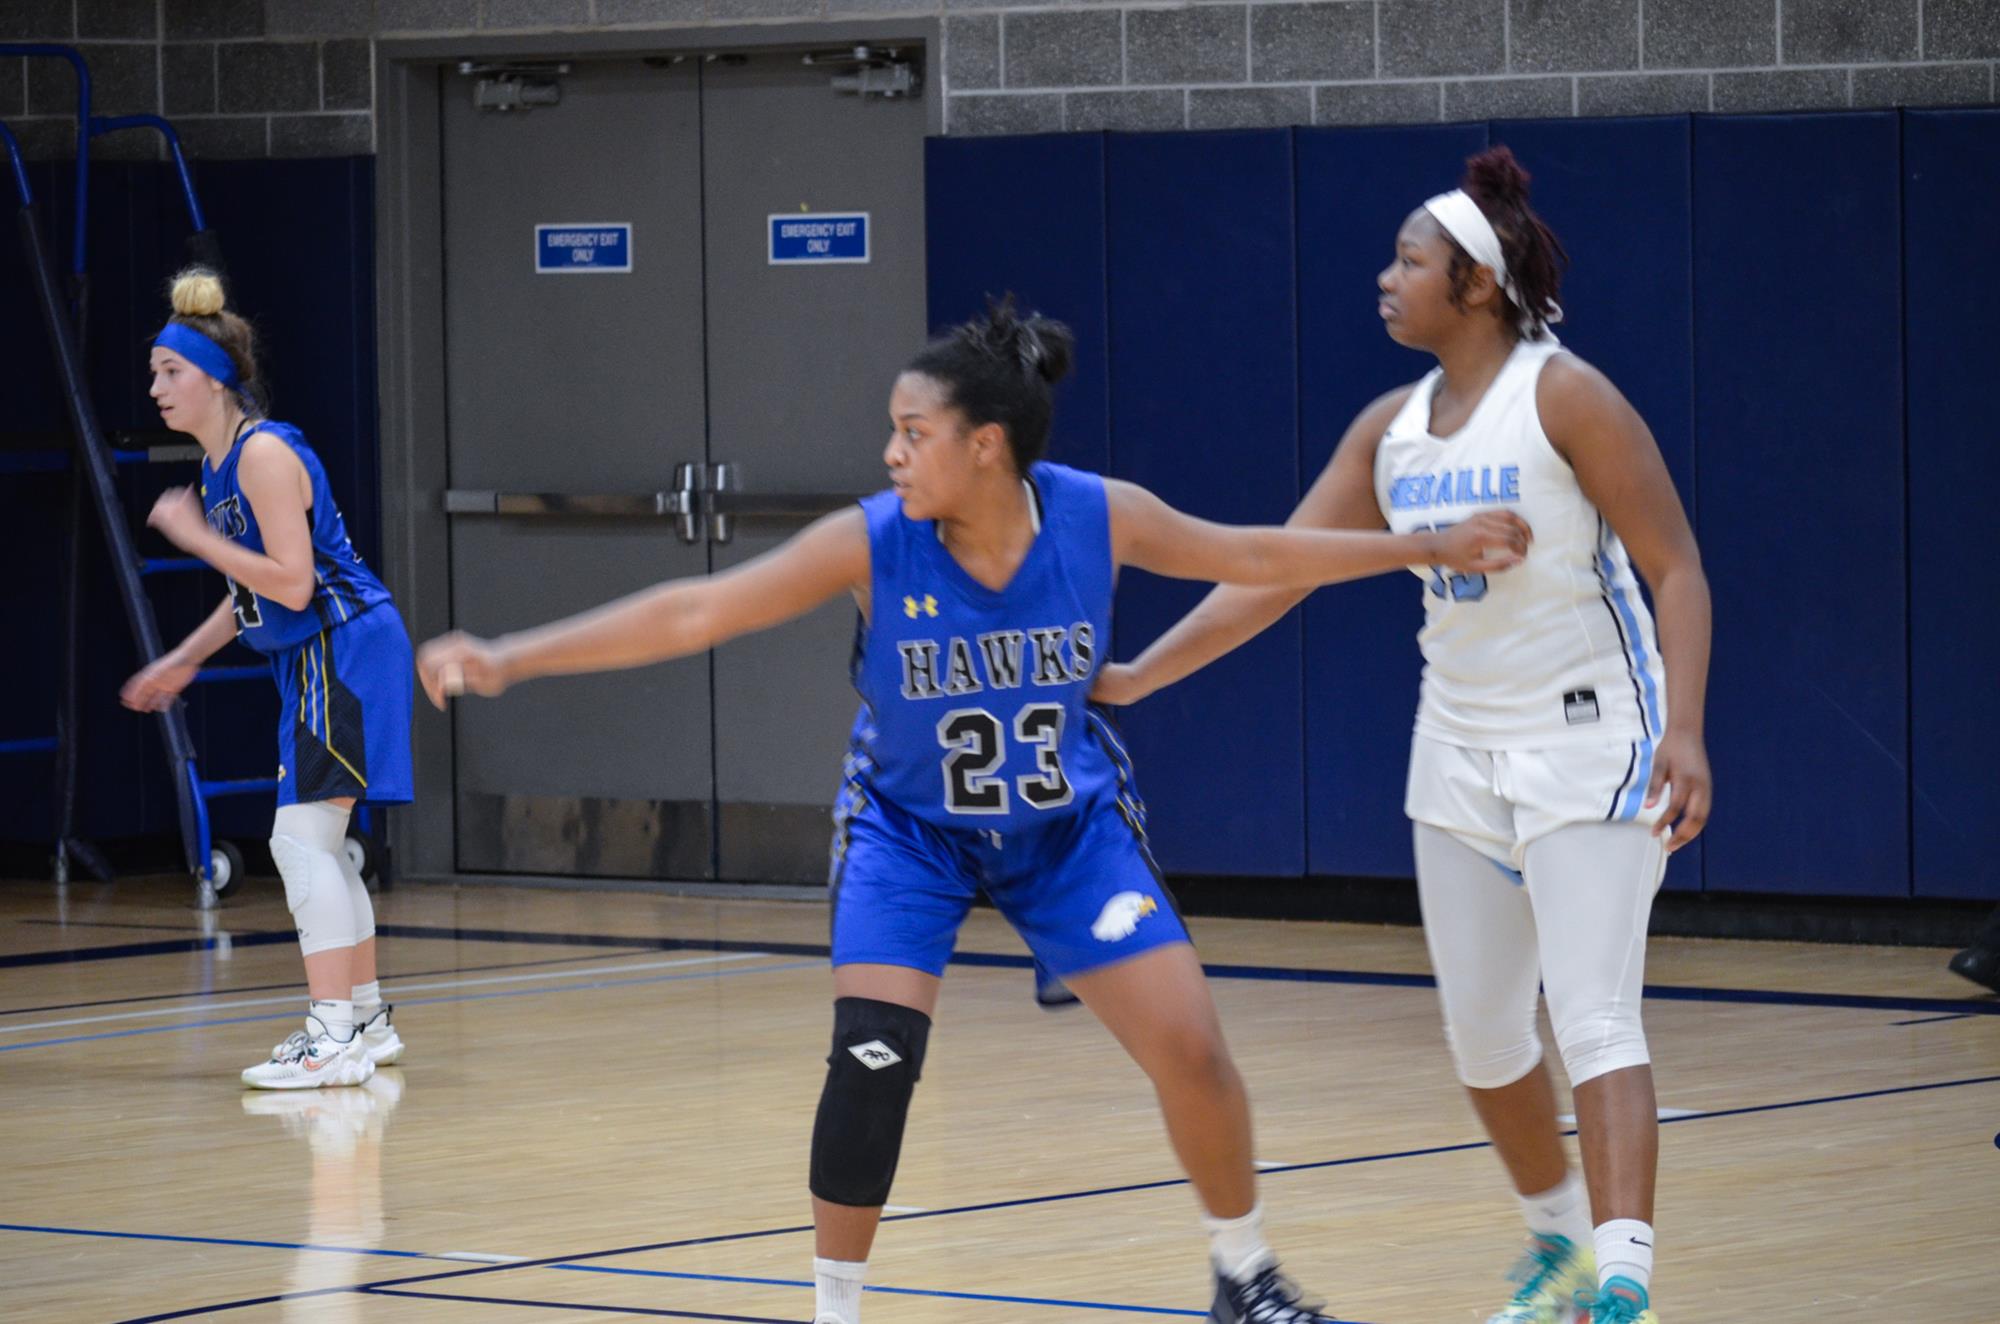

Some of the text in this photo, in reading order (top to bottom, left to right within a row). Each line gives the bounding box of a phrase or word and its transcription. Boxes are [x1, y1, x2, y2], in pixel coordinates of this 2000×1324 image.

[781, 222, 856, 238] EMERGENCY EXIT
[547, 232, 619, 247] EMERGENCY EXIT
[807, 239, 830, 253] ONLY
[572, 248, 594, 262] ONLY
[897, 621, 1095, 700] HAWKS
[936, 702, 1074, 814] 23
